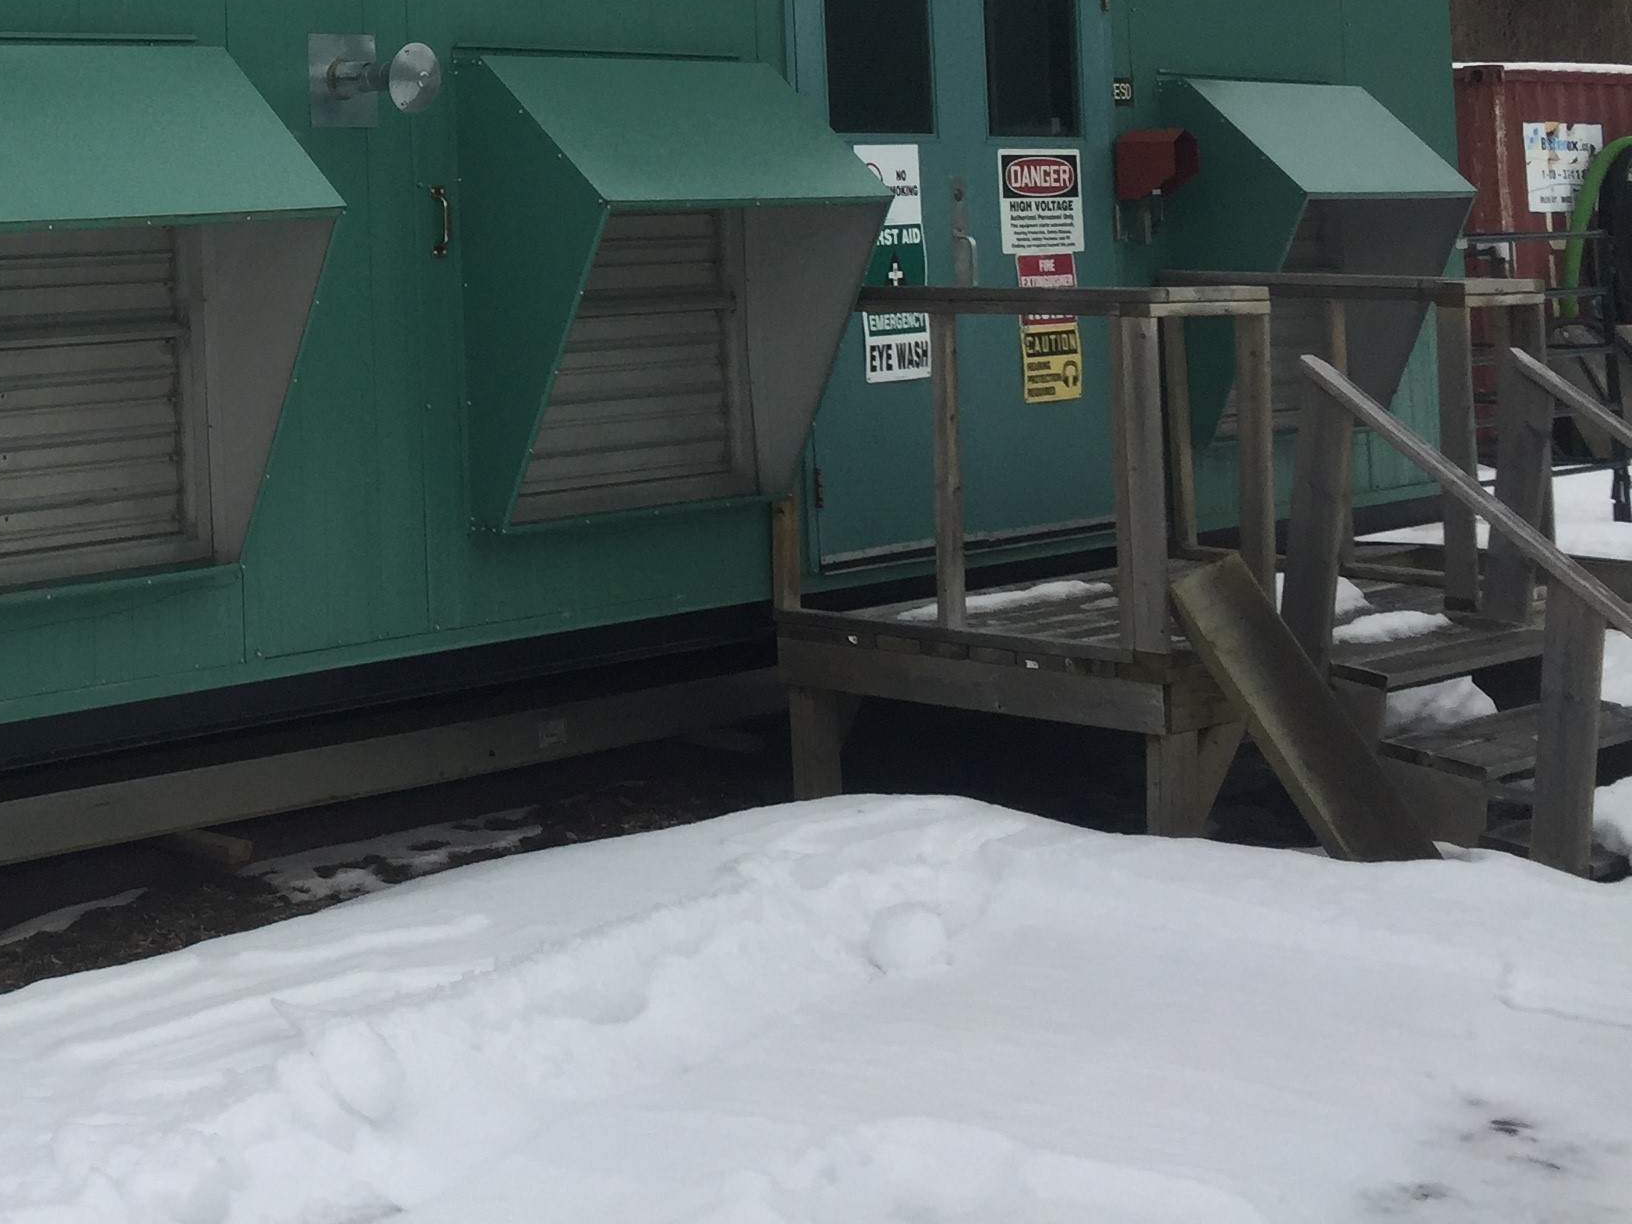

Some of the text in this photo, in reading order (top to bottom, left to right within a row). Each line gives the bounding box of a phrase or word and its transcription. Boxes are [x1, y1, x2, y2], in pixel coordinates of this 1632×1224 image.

[1113, 83, 1132, 99] ESD
[896, 170, 907, 181] NO
[1010, 165, 1070, 187] DANGER
[1009, 200, 1074, 212] HIGH VOLTAGE
[876, 227, 921, 245] RST AID
[1039, 259, 1055, 272] FIRE
[869, 312, 925, 331] EMERGENCY
[1025, 334, 1077, 353] CAUTION
[870, 340, 929, 373] EYE WASH
